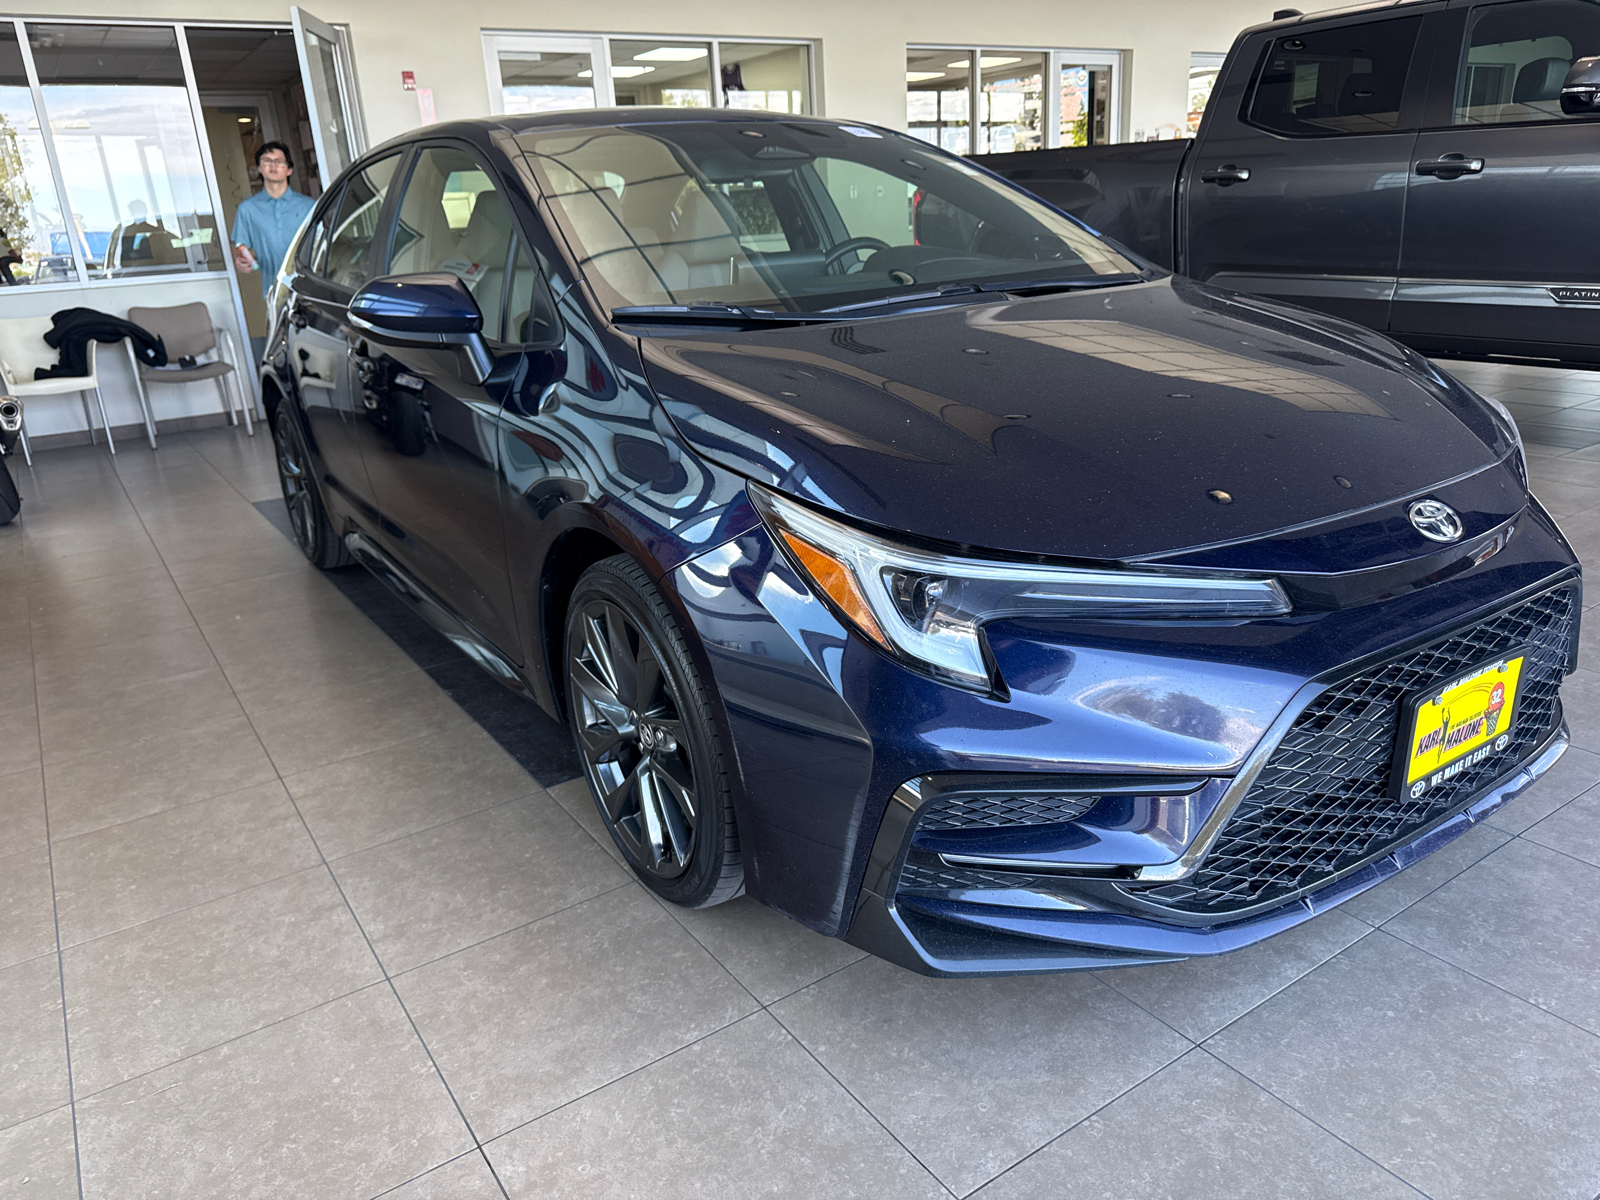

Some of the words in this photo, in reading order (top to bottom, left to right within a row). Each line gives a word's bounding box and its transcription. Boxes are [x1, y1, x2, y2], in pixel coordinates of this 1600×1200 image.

[1491, 688, 1502, 705] 32
[1414, 726, 1442, 758] KARL
[1443, 716, 1484, 753] MALONE
[1431, 771, 1443, 787] WE
[1444, 760, 1464, 780] MAKE
[1465, 754, 1473, 768] IT
[1473, 744, 1491, 764] EASY
